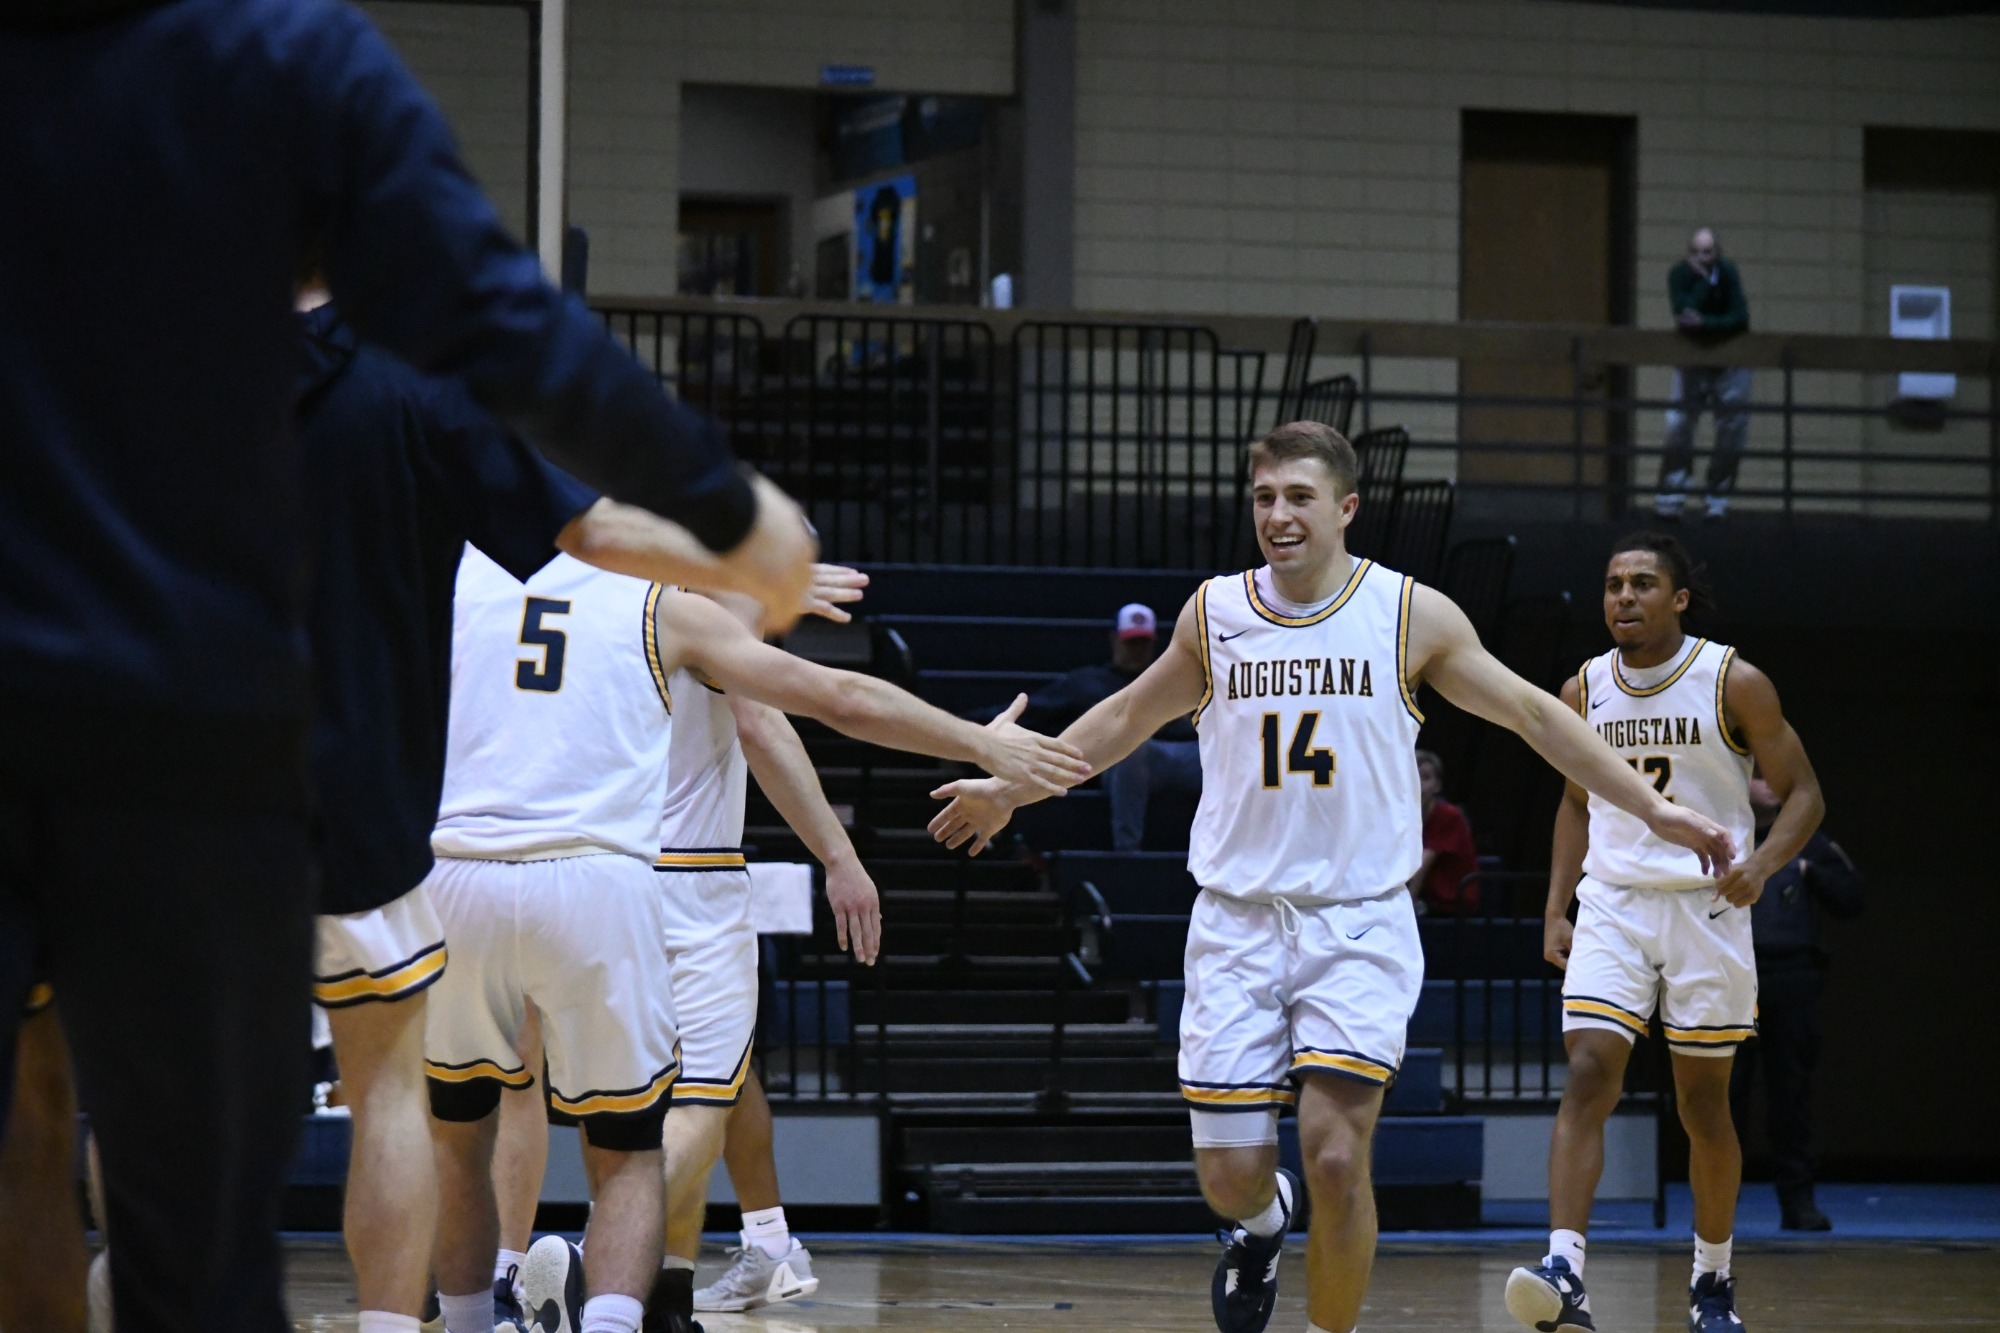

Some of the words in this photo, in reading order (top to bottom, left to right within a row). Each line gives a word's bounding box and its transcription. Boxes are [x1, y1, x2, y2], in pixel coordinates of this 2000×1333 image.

[515, 594, 574, 695] 5
[1228, 657, 1373, 700] AUGUSTANA
[1260, 710, 1337, 790] 14
[1625, 755, 1675, 805] 2
